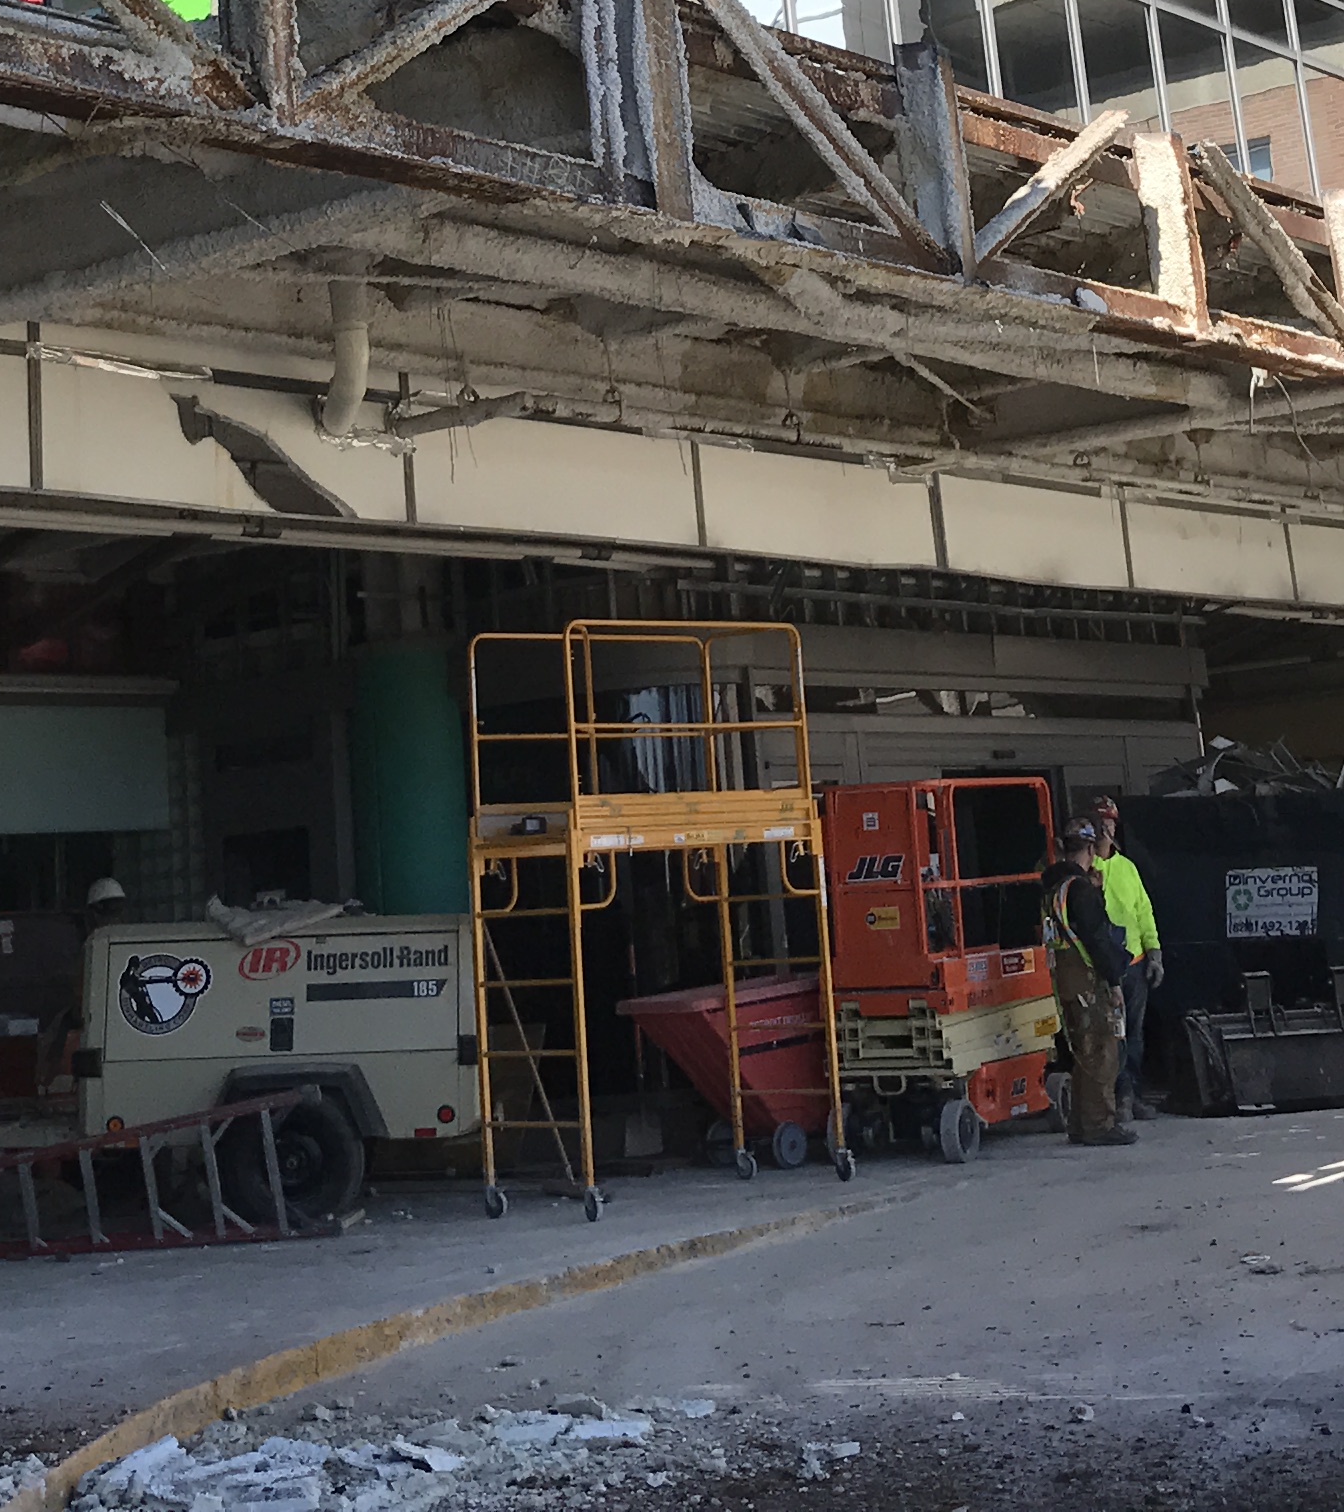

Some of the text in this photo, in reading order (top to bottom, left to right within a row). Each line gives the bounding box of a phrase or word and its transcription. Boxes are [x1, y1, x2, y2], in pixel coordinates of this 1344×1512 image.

[846, 854, 905, 883] JLG
[1257, 886, 1313, 898] Group
[249, 947, 291, 974] IR
[413, 981, 438, 997] 185
